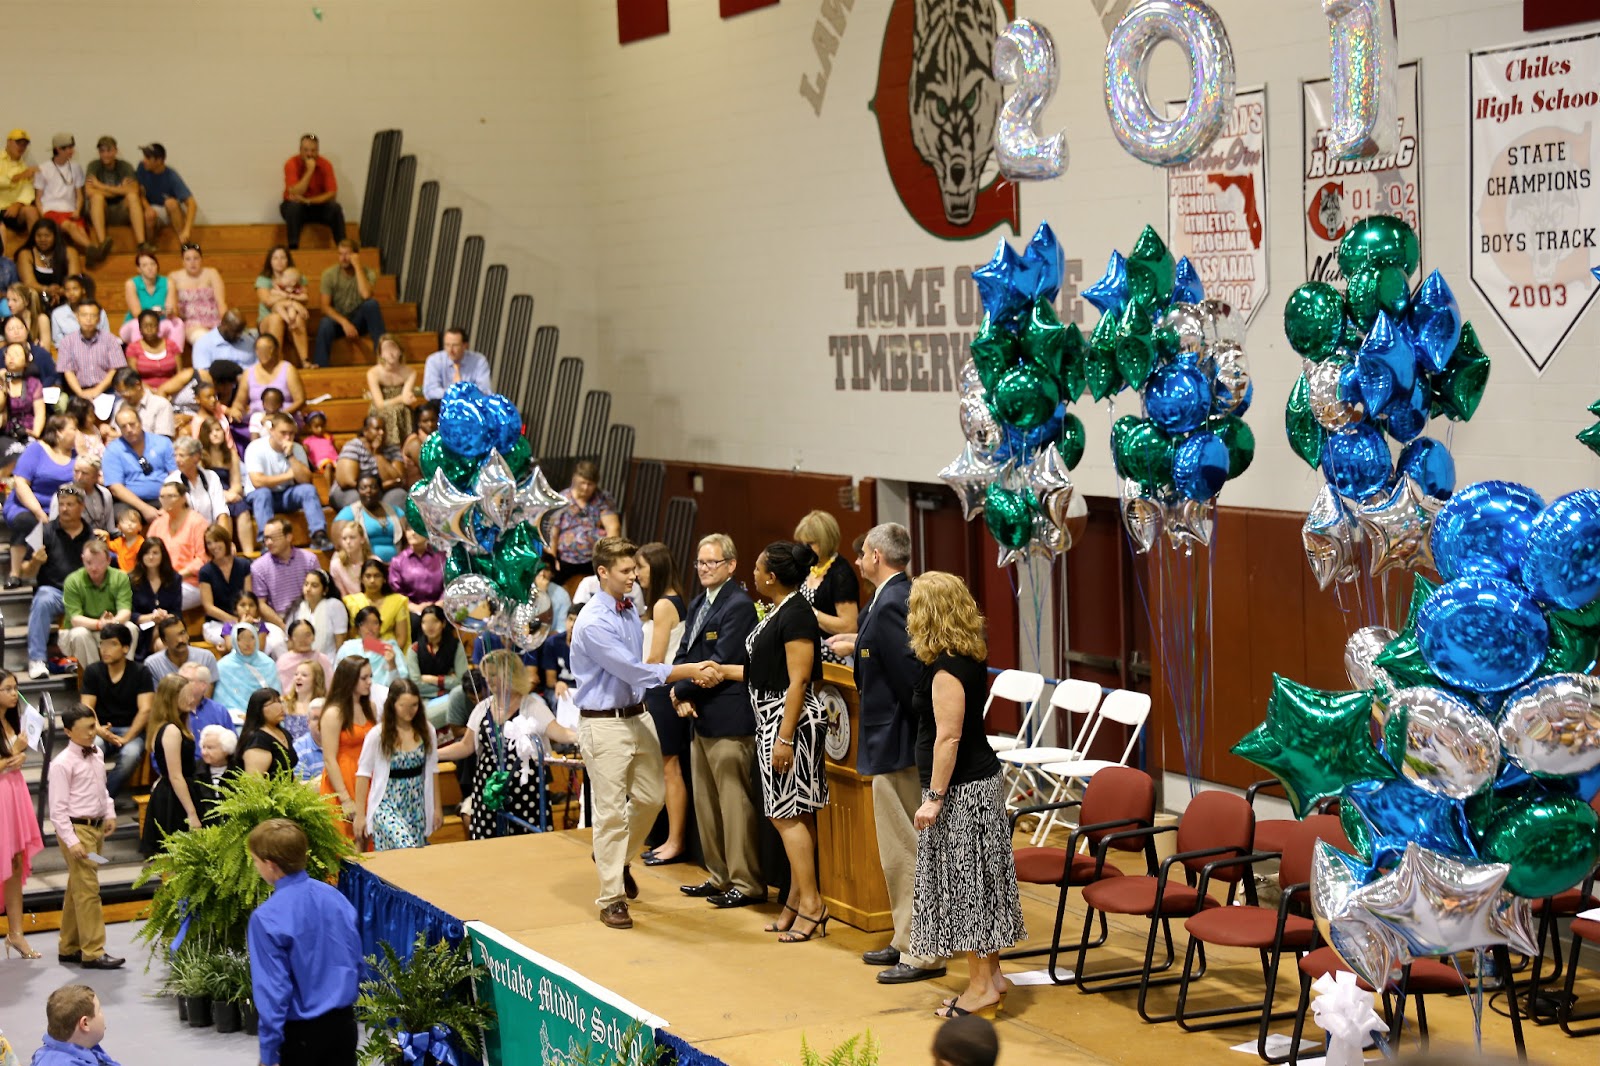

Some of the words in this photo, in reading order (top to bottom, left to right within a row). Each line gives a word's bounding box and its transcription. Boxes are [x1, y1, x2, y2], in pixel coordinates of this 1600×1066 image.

[1505, 55, 1572, 82] Chiles
[1476, 94, 1523, 123] High
[1531, 88, 1600, 114] Schoo
[1508, 141, 1566, 166] STATE
[1487, 169, 1591, 196] CHAMPIONS
[1177, 193, 1217, 215] SCHOOL
[1184, 211, 1237, 234] ATHLETIC
[1191, 231, 1247, 253] PROGRAM
[1481, 232, 1526, 253] BOYS
[1535, 228, 1597, 250] TRACK
[1509, 283, 1568, 308] 2003
[475, 937, 534, 1003] Deerlake
[537, 975, 587, 1034] Middle
